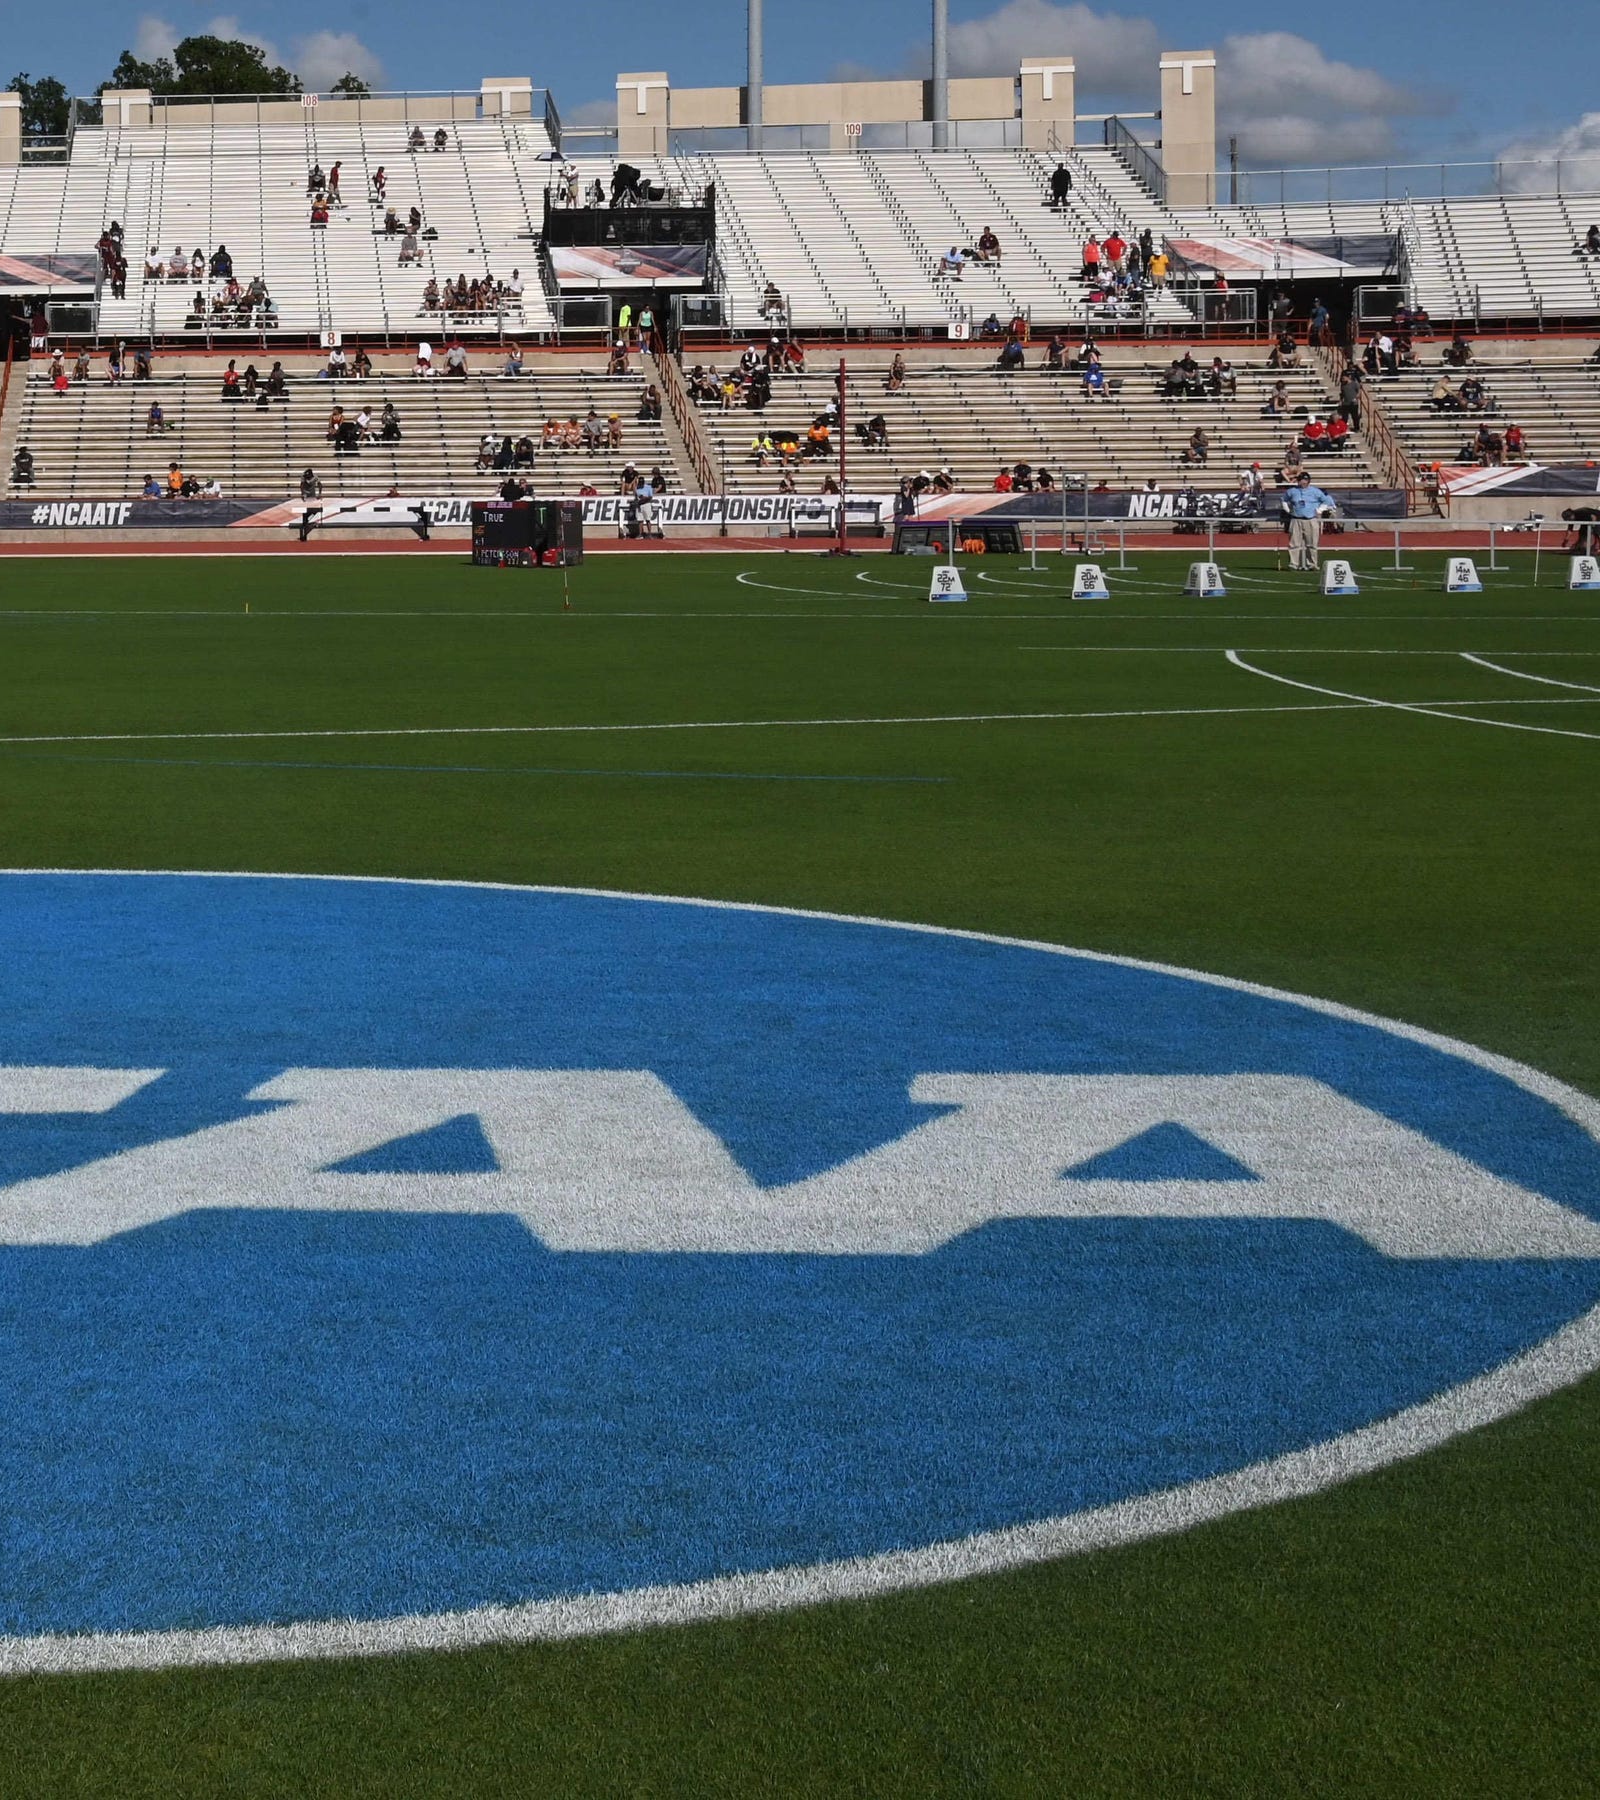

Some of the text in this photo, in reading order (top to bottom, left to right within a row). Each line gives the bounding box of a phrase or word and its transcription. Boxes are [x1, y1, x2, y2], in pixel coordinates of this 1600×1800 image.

[303, 95, 317, 106] 108
[846, 123, 861, 135] 109
[954, 325, 962, 338] 9
[327, 332, 335, 346] 8
[1128, 493, 1257, 517] NCACO
[31, 502, 133, 526] #NCAATF
[1081, 571, 1098, 581] 20M
[1455, 566, 1471, 574] 14M
[937, 574, 955, 583] 22M
